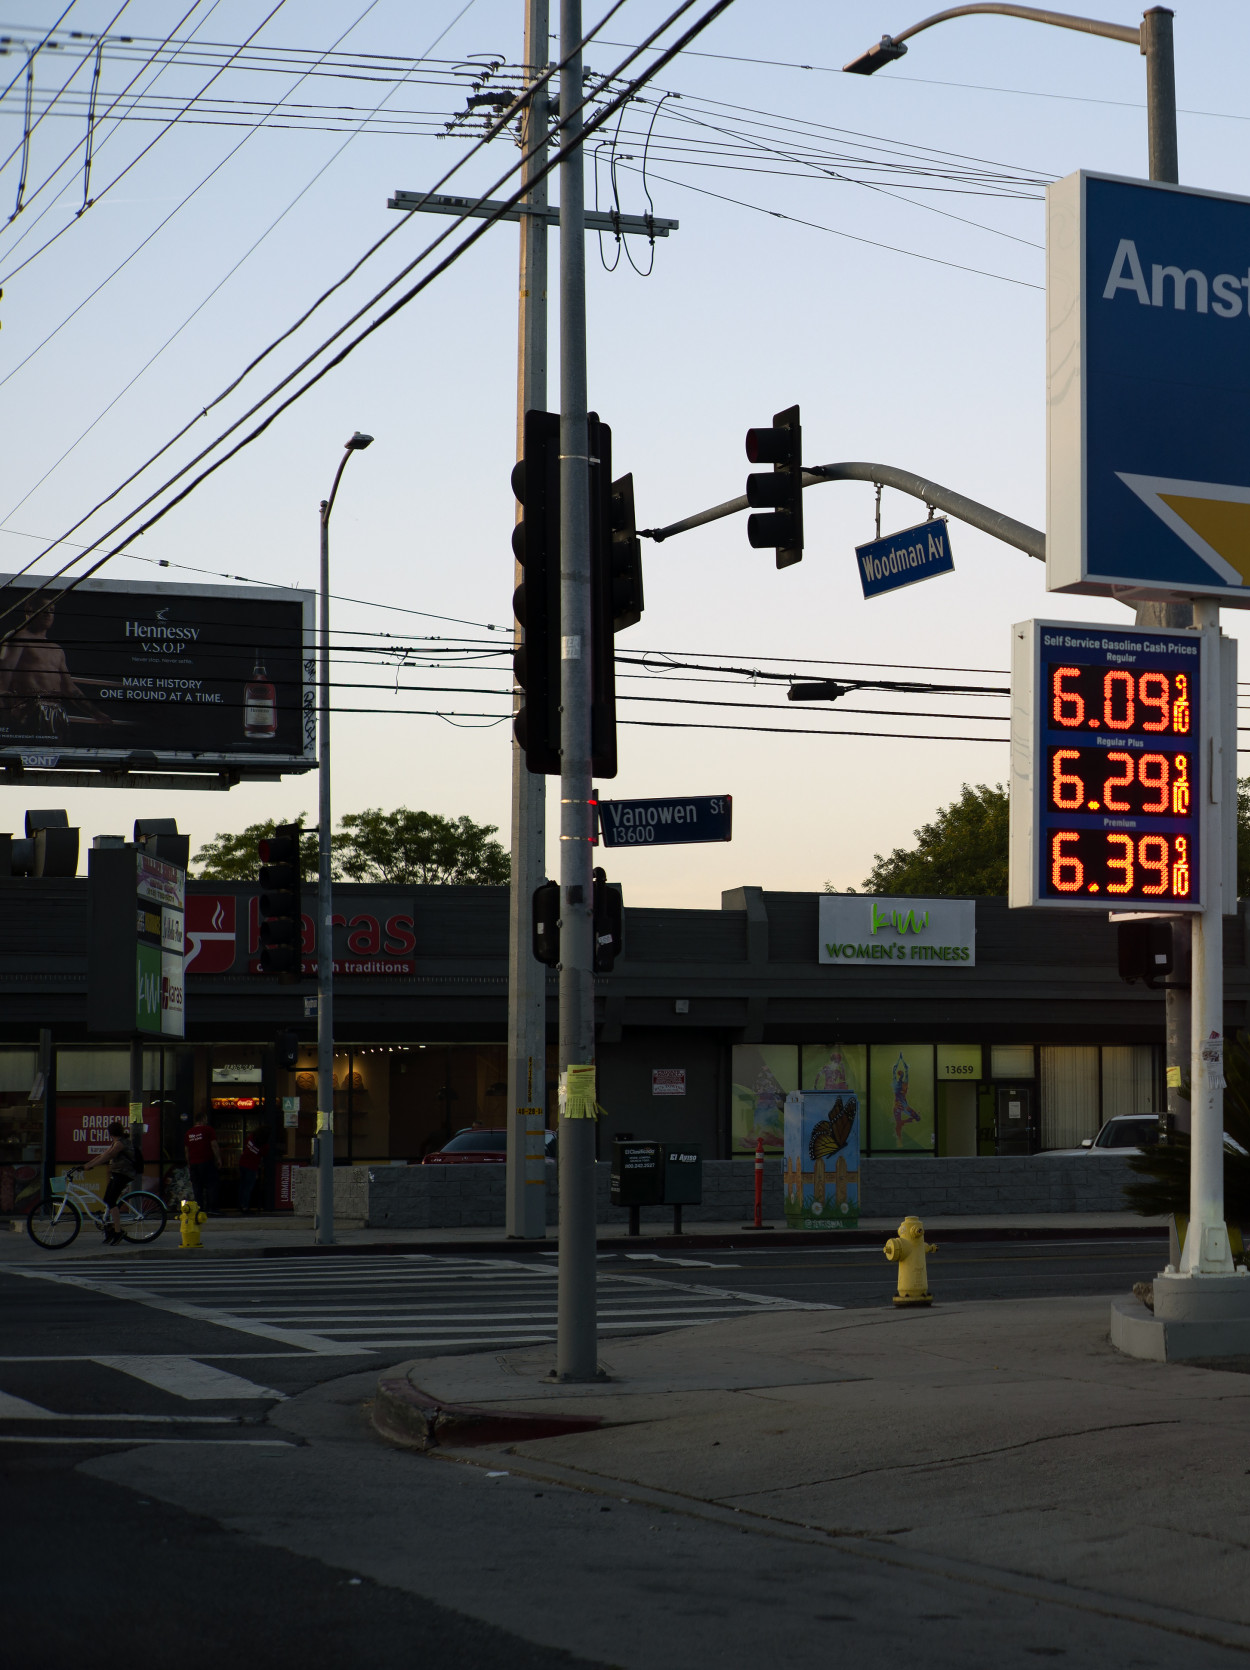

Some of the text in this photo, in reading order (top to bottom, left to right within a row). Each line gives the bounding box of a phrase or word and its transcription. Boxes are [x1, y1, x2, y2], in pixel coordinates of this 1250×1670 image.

[861, 533, 944, 583] Woodman Av
[125, 621, 200, 641] Hennessy
[1044, 635, 1197, 655] Self Service Gasoline Cash Prices
[1106, 652, 1136, 664] Regular
[122, 677, 202, 689] MAKE HISTORY
[100, 689, 224, 703] ONE ROUND AT A TIME.
[1053, 667, 1169, 731] 6.09
[1096, 736, 1144, 748] Regular Plus
[1053, 749, 1169, 813] 6.29
[608, 798, 724, 827] Vanowen St
[1104, 818, 1136, 829] Premium
[612, 826, 655, 843] 13600
[1052, 832, 1169, 895] 6.39
[826, 942, 970, 962] WOMEN'S FITNESS
[344, 962, 410, 973] traditions
[944, 1064, 975, 1075] 13659
[73, 1129, 86, 1142] ON
[678, 1154, 697, 1162] Aviso
[281, 1164, 291, 1202] LAHMAJOUN
